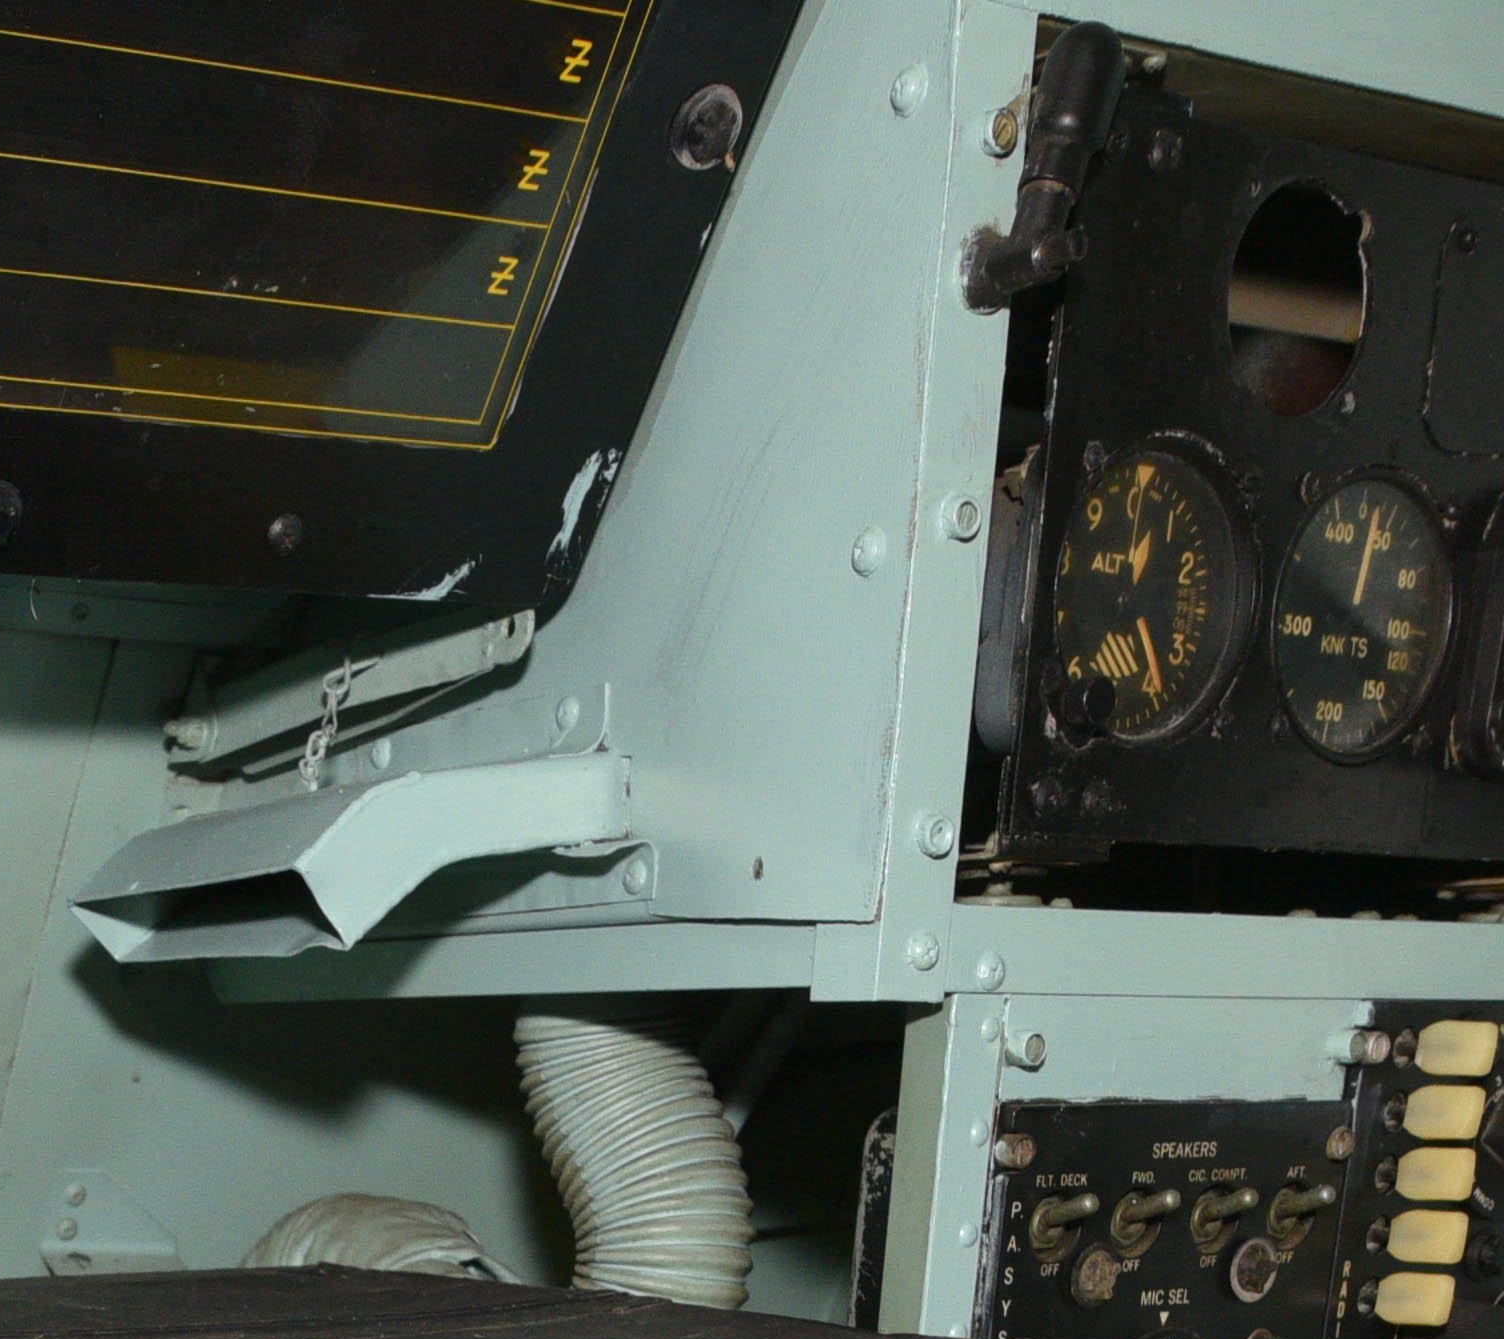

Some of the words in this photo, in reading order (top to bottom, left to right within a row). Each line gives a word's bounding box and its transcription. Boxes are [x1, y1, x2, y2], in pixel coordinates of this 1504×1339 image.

[1087, 498, 1103, 530] 9
[1325, 522, 1354, 544] 400
[1092, 552, 1125, 575] ALT
[1179, 551, 1194, 584] 2
[1398, 569, 1416, 589] 80
[1283, 613, 1312, 637] 300
[1387, 618, 1410, 640] 100
[1169, 634, 1184, 665] 3
[1387, 650, 1409, 672] 120
[1363, 679, 1385, 700] 150
[1316, 700, 1342, 722] 200
[1152, 1142, 1217, 1159] SPEAKERS
[1060, 1172, 1088, 1187] DECK
[1040, 1263, 1059, 1278] OFF
[1122, 1258, 1140, 1273] OFF
[1199, 1255, 1217, 1268] OFF
[1141, 1291, 1165, 1306] MIC
[1169, 1290, 1189, 1305] SEL
